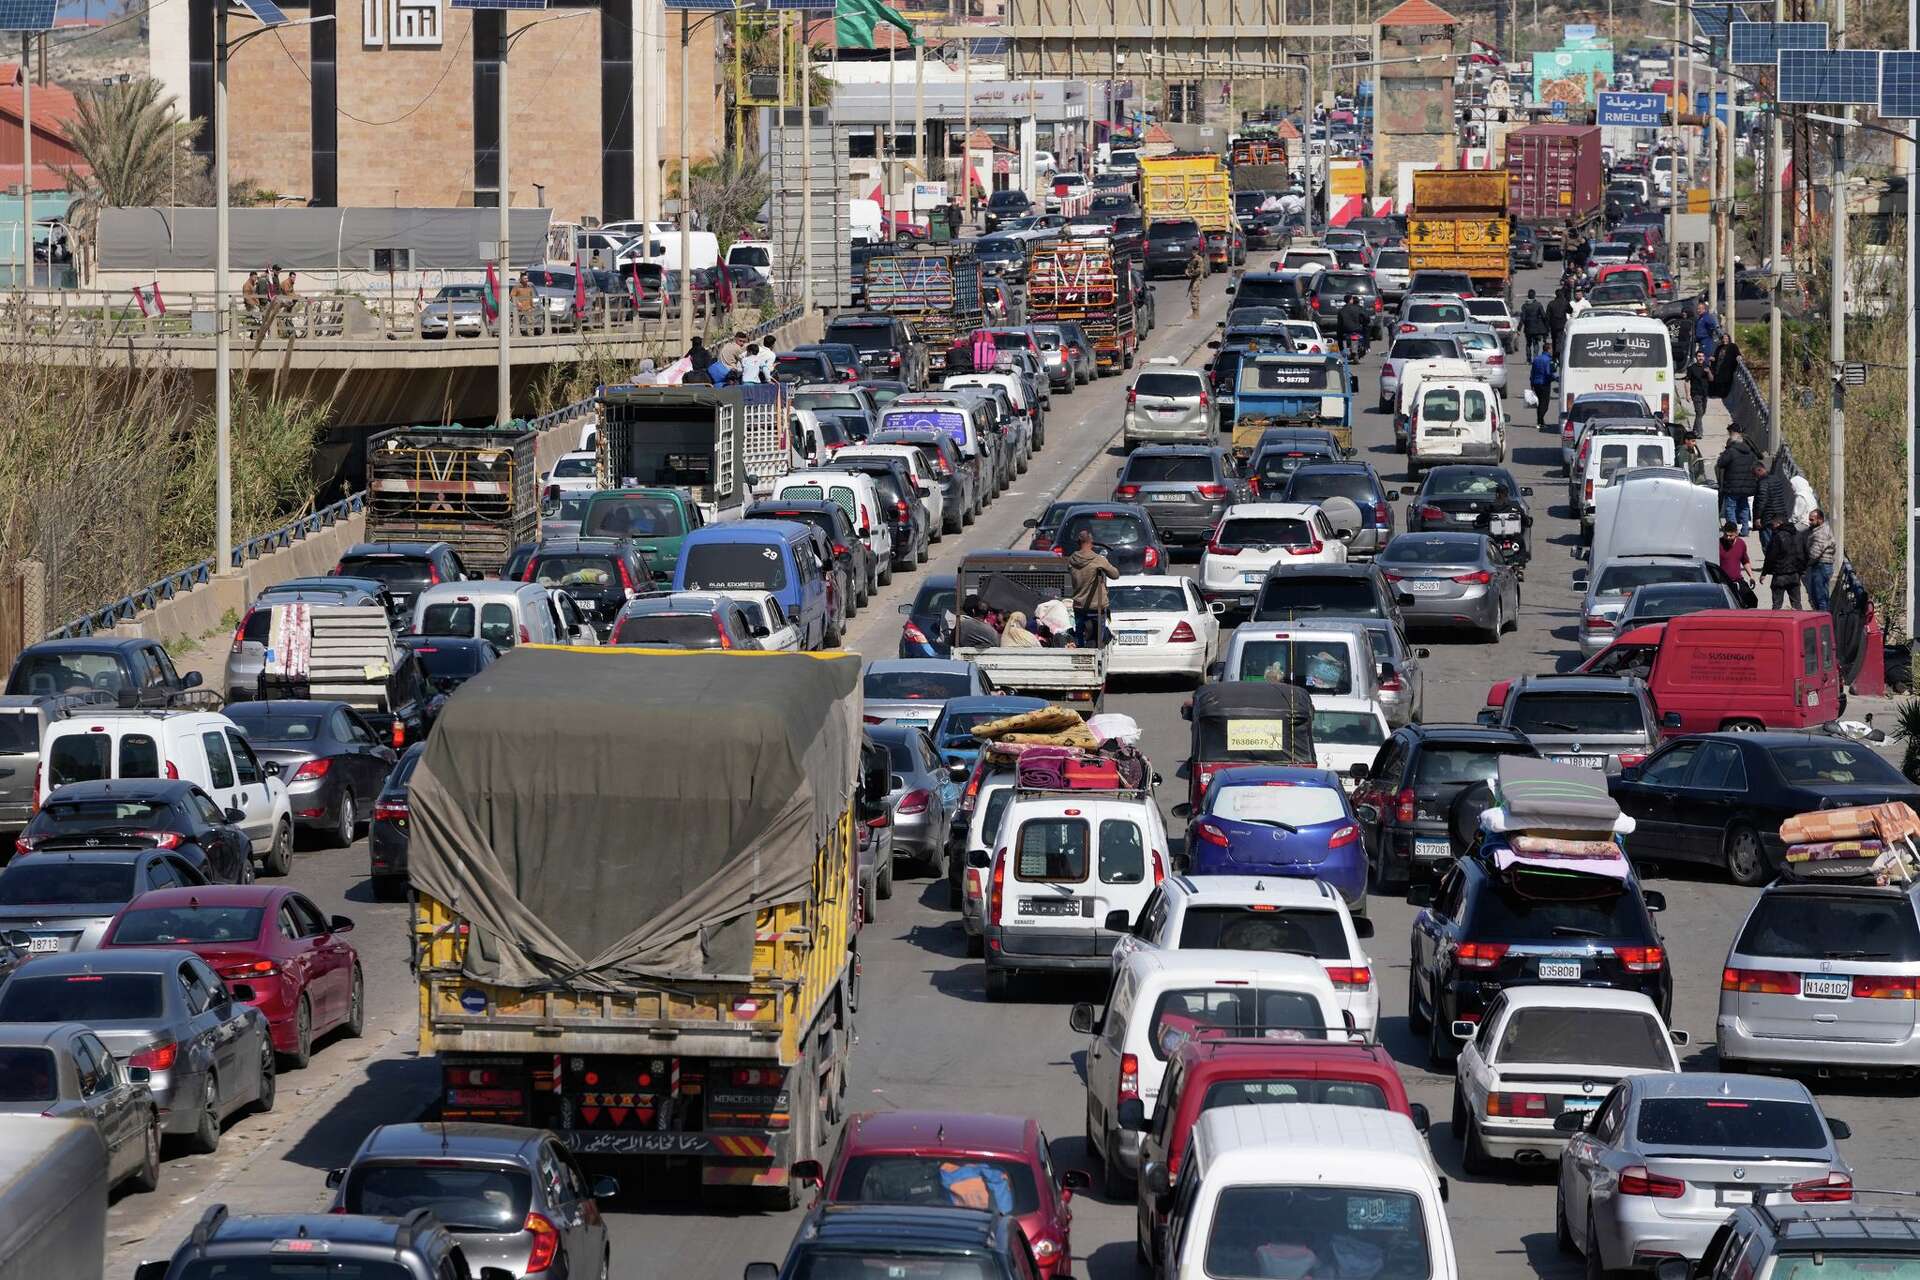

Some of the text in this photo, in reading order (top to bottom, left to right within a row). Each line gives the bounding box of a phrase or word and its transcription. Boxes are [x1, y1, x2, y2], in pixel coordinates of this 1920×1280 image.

[1605, 95, 1656, 110] الرميلة
[1605, 112, 1658, 123] RMEILEH
[1626, 337, 1650, 349] نقليا
[1594, 383, 1643, 391] NISSAN
[762, 548, 778, 561] 29
[1416, 844, 1450, 855] S177061
[32, 939, 58, 951] 18713
[1805, 981, 1848, 995] N148102
